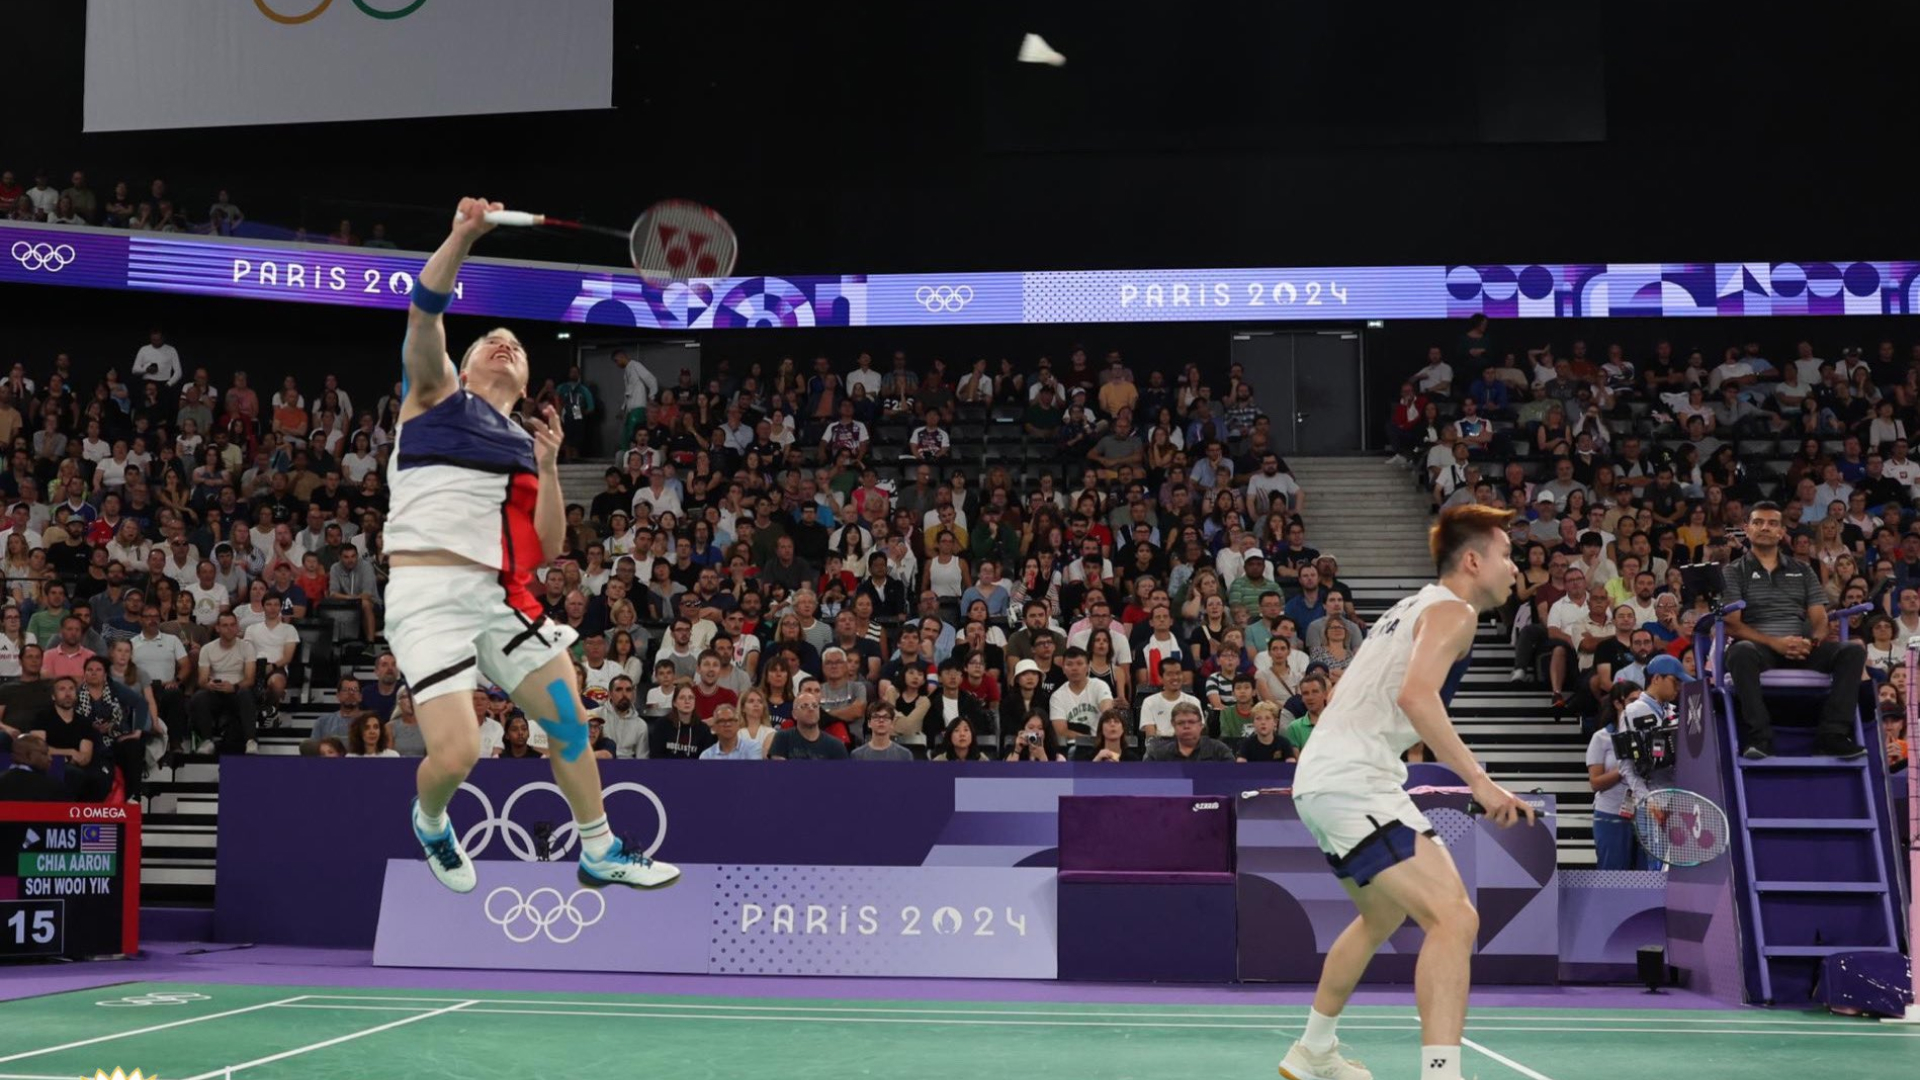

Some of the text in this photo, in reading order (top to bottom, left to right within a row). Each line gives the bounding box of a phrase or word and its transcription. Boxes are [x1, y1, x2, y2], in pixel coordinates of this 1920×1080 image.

[1247, 281, 1348, 306] 2024
[83, 807, 127, 818] OMEGA
[45, 828, 77, 849] MAS
[36, 854, 111, 872] CHIA AARON
[25, 877, 110, 895] SOH WOOI YIK
[7, 909, 56, 944] 15
[900, 905, 1027, 936] 2024
